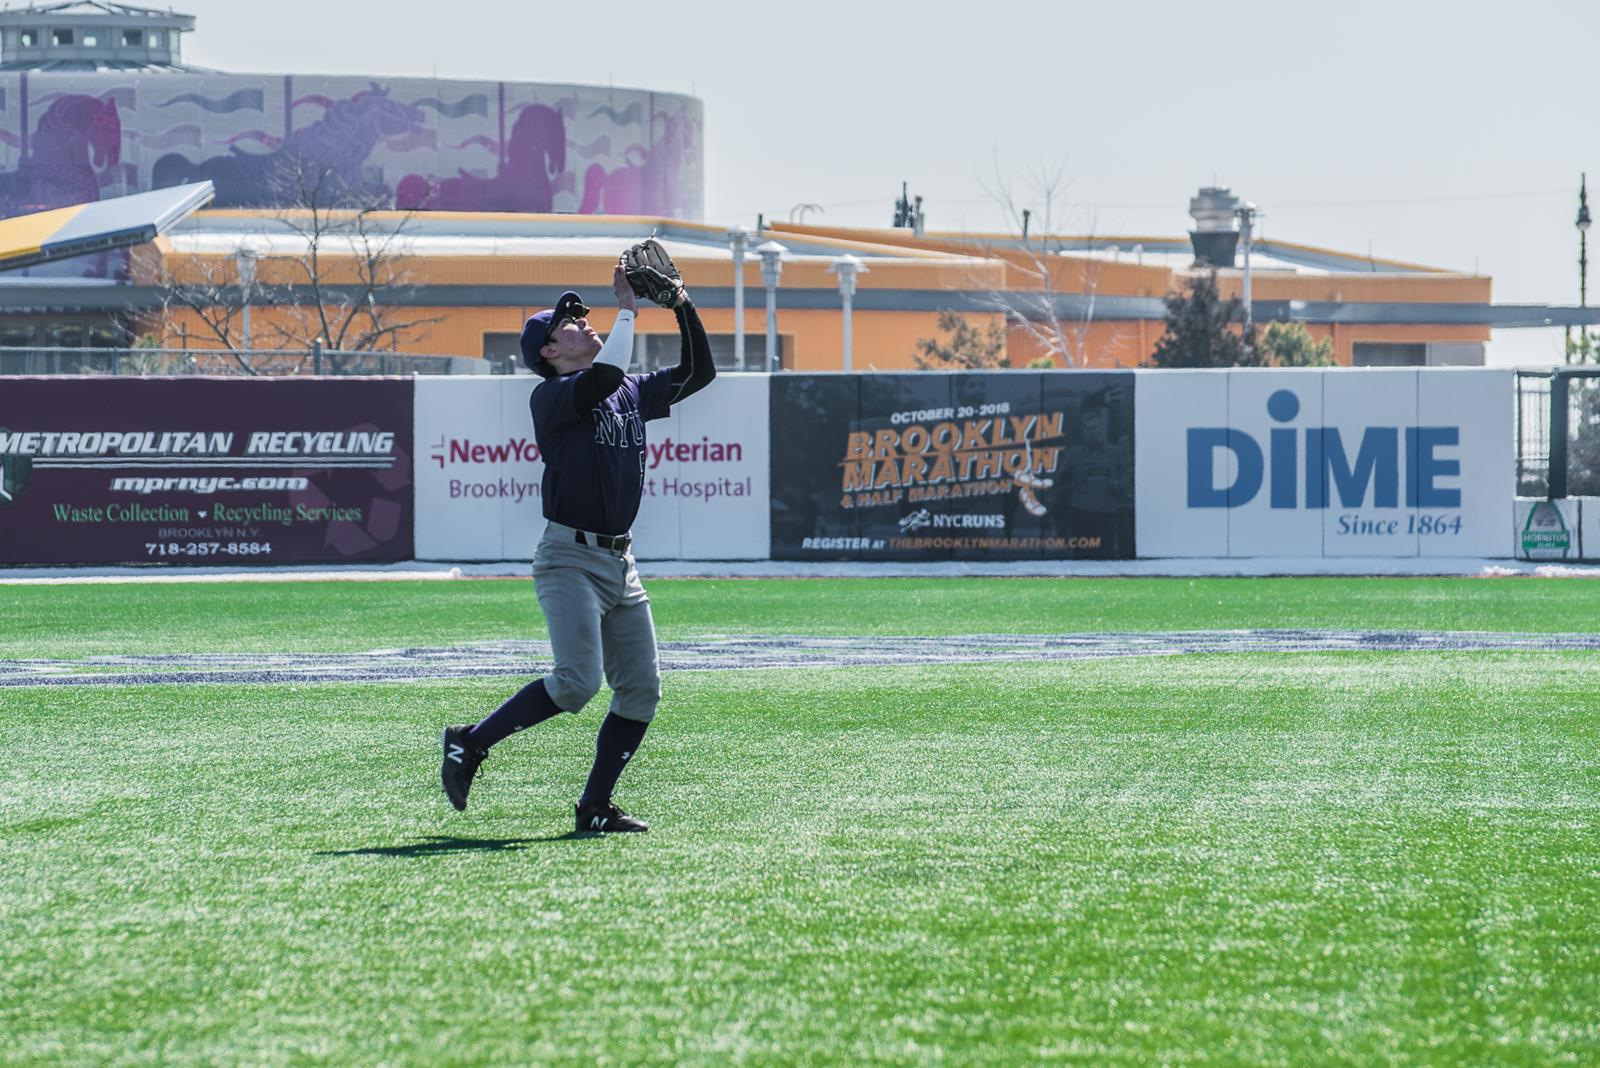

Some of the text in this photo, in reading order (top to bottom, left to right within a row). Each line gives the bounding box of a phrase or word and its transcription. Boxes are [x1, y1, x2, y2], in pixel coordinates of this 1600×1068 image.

[890, 409, 954, 424] OCTOBER
[0, 431, 395, 455] METROPOLITAN RECYCLING
[845, 412, 1065, 463] BROOKLYN
[841, 449, 1059, 492] MARATHON
[110, 476, 308, 494] mprnyc.com
[449, 479, 540, 503] Brooklyn
[663, 477, 752, 502] Hospital
[840, 482, 1014, 508] & HALF MARATHON
[53, 502, 363, 526] Waste Collection Recycling Services
[933, 514, 1006, 528] NYCRUNS
[1336, 513, 1463, 535] Since 1864
[158, 527, 234, 539] BROOKLYN
[801, 537, 871, 550] REGISTER
[888, 536, 1102, 549] THEBROOKLYNMARATHON.COM
[145, 542, 272, 556] 718-257-8584
